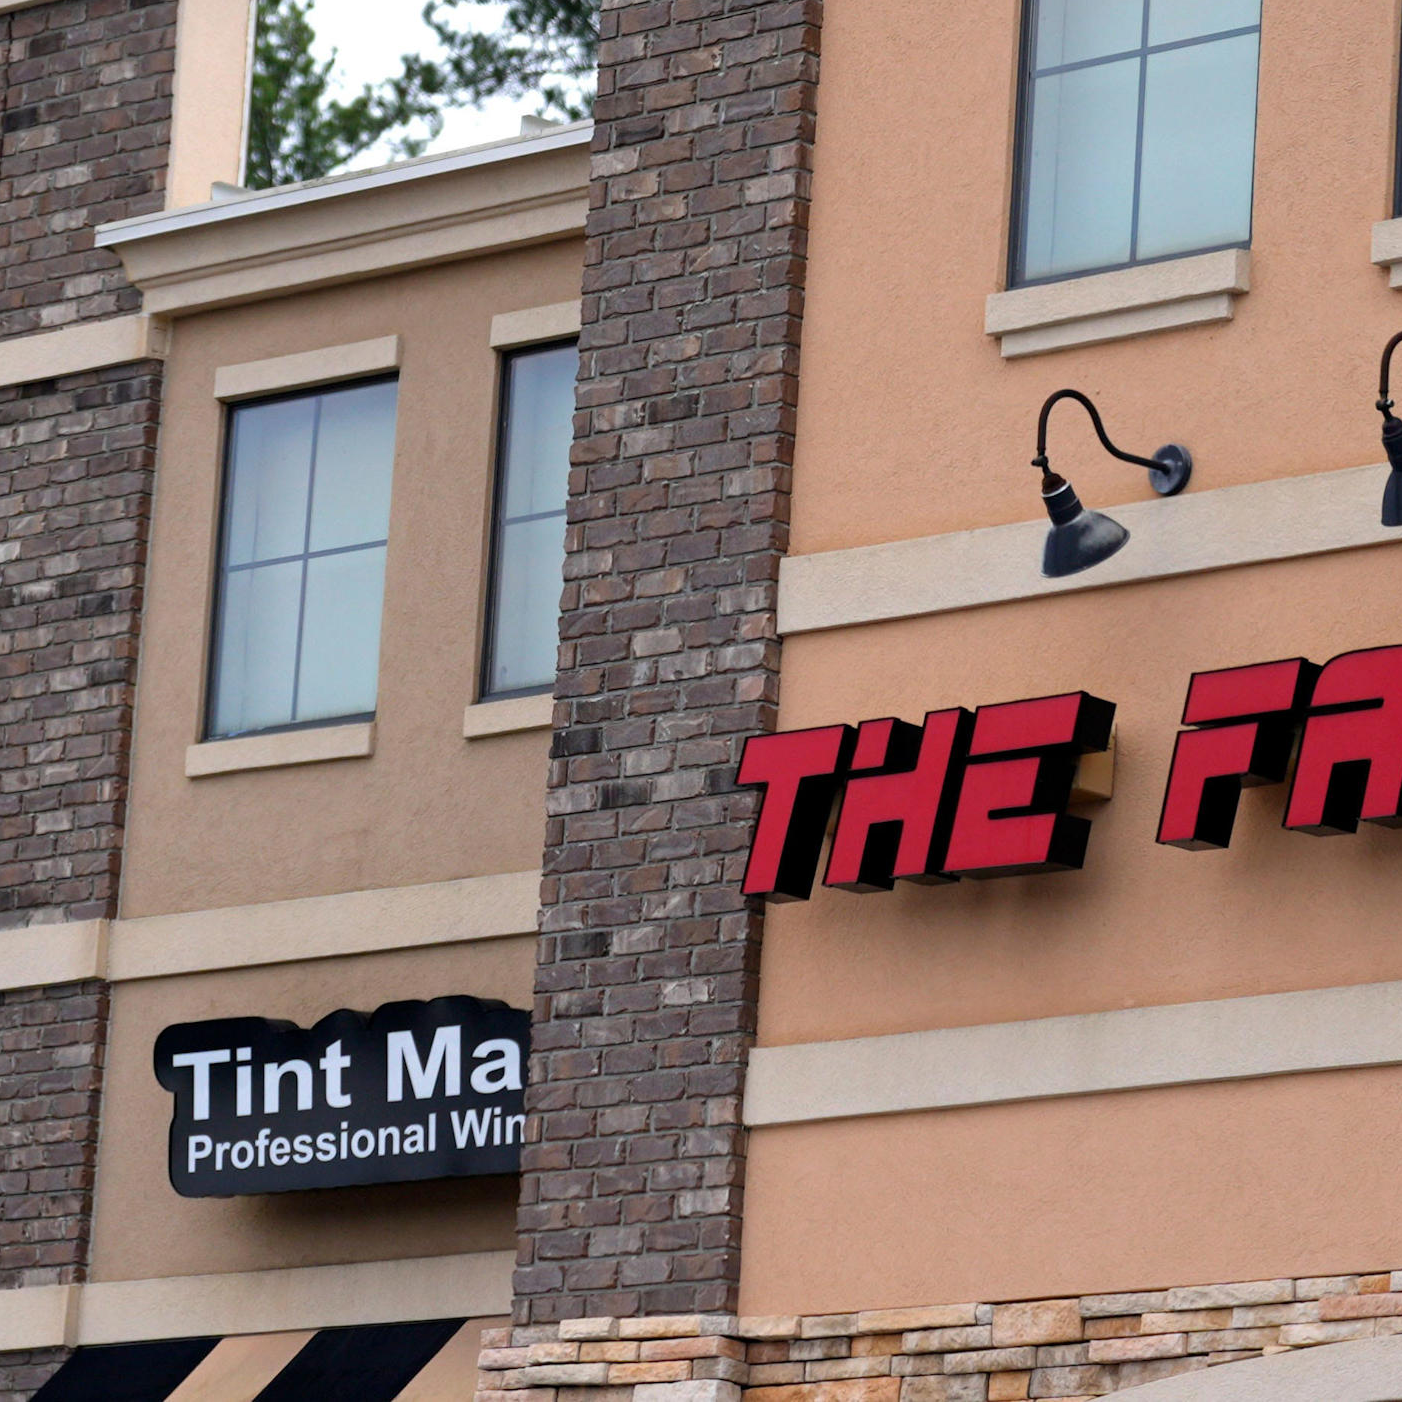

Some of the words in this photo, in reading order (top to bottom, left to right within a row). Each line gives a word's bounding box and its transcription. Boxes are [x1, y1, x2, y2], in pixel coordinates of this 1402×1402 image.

[736, 690, 1098, 898] THE
[172, 1039, 352, 1121] Tint
[386, 1024, 523, 1103] Ma
[187, 1113, 436, 1174] Professional
